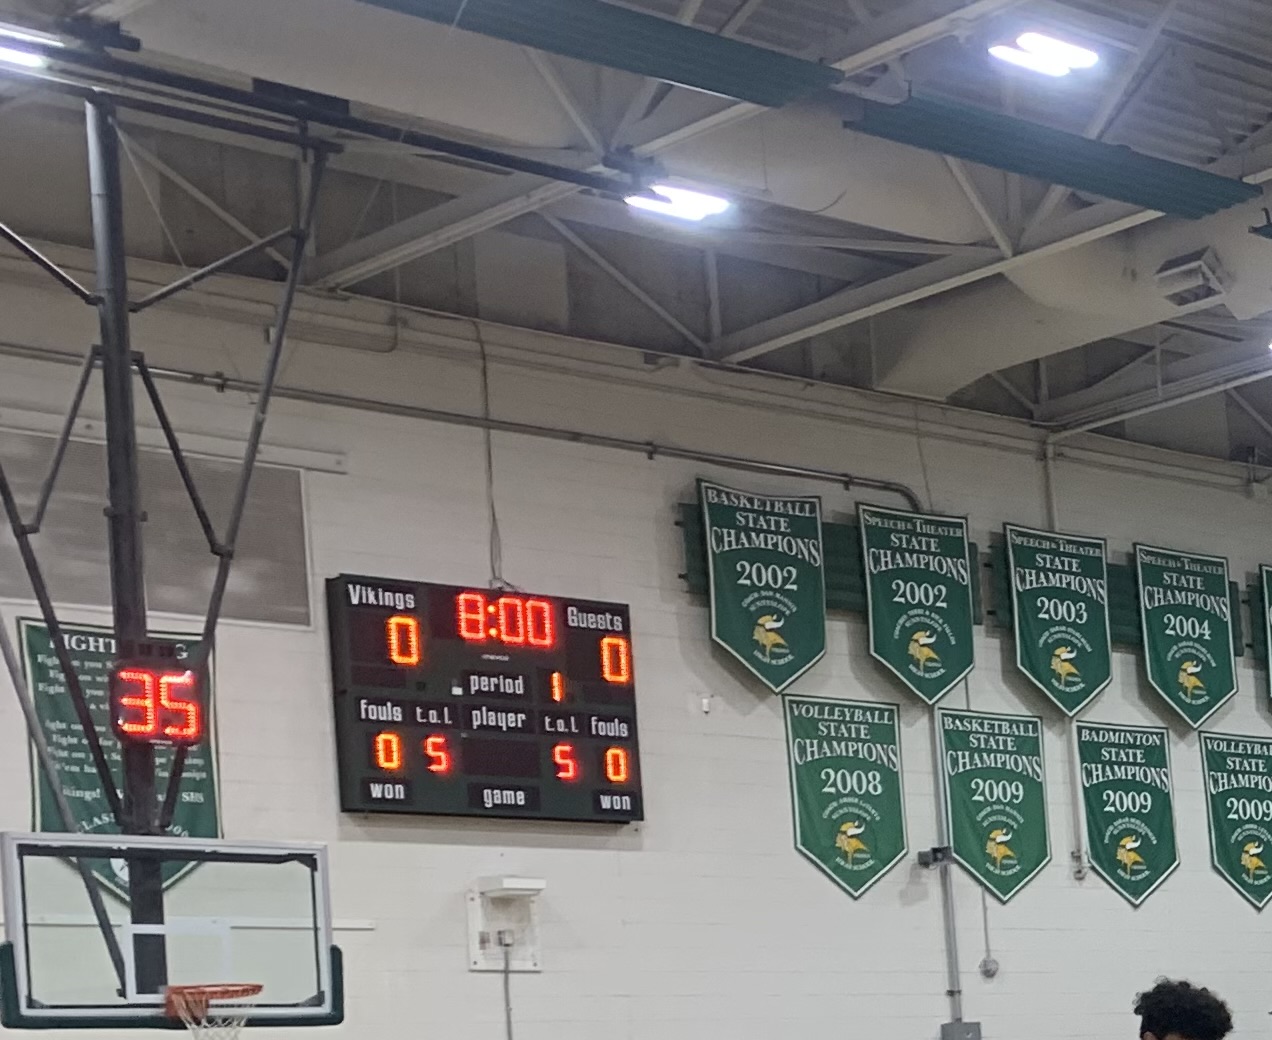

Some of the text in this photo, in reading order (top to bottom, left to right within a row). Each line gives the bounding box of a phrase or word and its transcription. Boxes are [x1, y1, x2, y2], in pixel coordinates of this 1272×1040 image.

[735, 512, 791, 532] STATE
[711, 526, 820, 566] CHAMPIONS
[890, 534, 940, 552] STATE
[736, 560, 798, 591] 2002
[868, 548, 968, 585] CHAMPIONS
[1035, 553, 1081, 573] STATE
[892, 580, 947, 608] 2002
[1016, 567, 1105, 605] CHAMPIONS
[1163, 572, 1205, 590] STATE
[348, 584, 415, 609] Vikings
[1144, 585, 1228, 622] CHAMPIONS
[457, 592, 553, 648] 8:00
[567, 607, 622, 631] Guests
[1036, 597, 1088, 624] 2003
[388, 615, 420, 665] 0
[1163, 614, 1212, 640] 2004
[601, 635, 629, 682] 0
[470, 675, 524, 695] period
[551, 671, 563, 702] 1
[118, 669, 199, 737] 35
[791, 703, 893, 724] VOLLEYBALL
[360, 699, 402, 722] fouls
[471, 707, 526, 731] player
[591, 717, 628, 737] fouls
[818, 722, 871, 739] STATE
[943, 716, 1038, 737] BASKETBALL
[375, 732, 401, 769] 0
[969, 734, 1016, 751] STATE
[1081, 729, 1161, 746] BADMINTON
[424, 736, 449, 773] 5
[554, 744, 578, 779] 5
[605, 747, 628, 782] 0
[793, 738, 898, 772] CHAMPIONS
[946, 750, 1042, 782] CHAMPIONS
[1101, 748, 1146, 764] STATE
[1226, 757, 1267, 772] STATE
[370, 782, 405, 800] won
[821, 768, 882, 796] 2008
[970, 778, 1024, 803] 2009
[1081, 763, 1170, 793] CHAMPIONS
[483, 788, 525, 808] game
[600, 794, 631, 811] won
[1102, 790, 1152, 813] 2009
